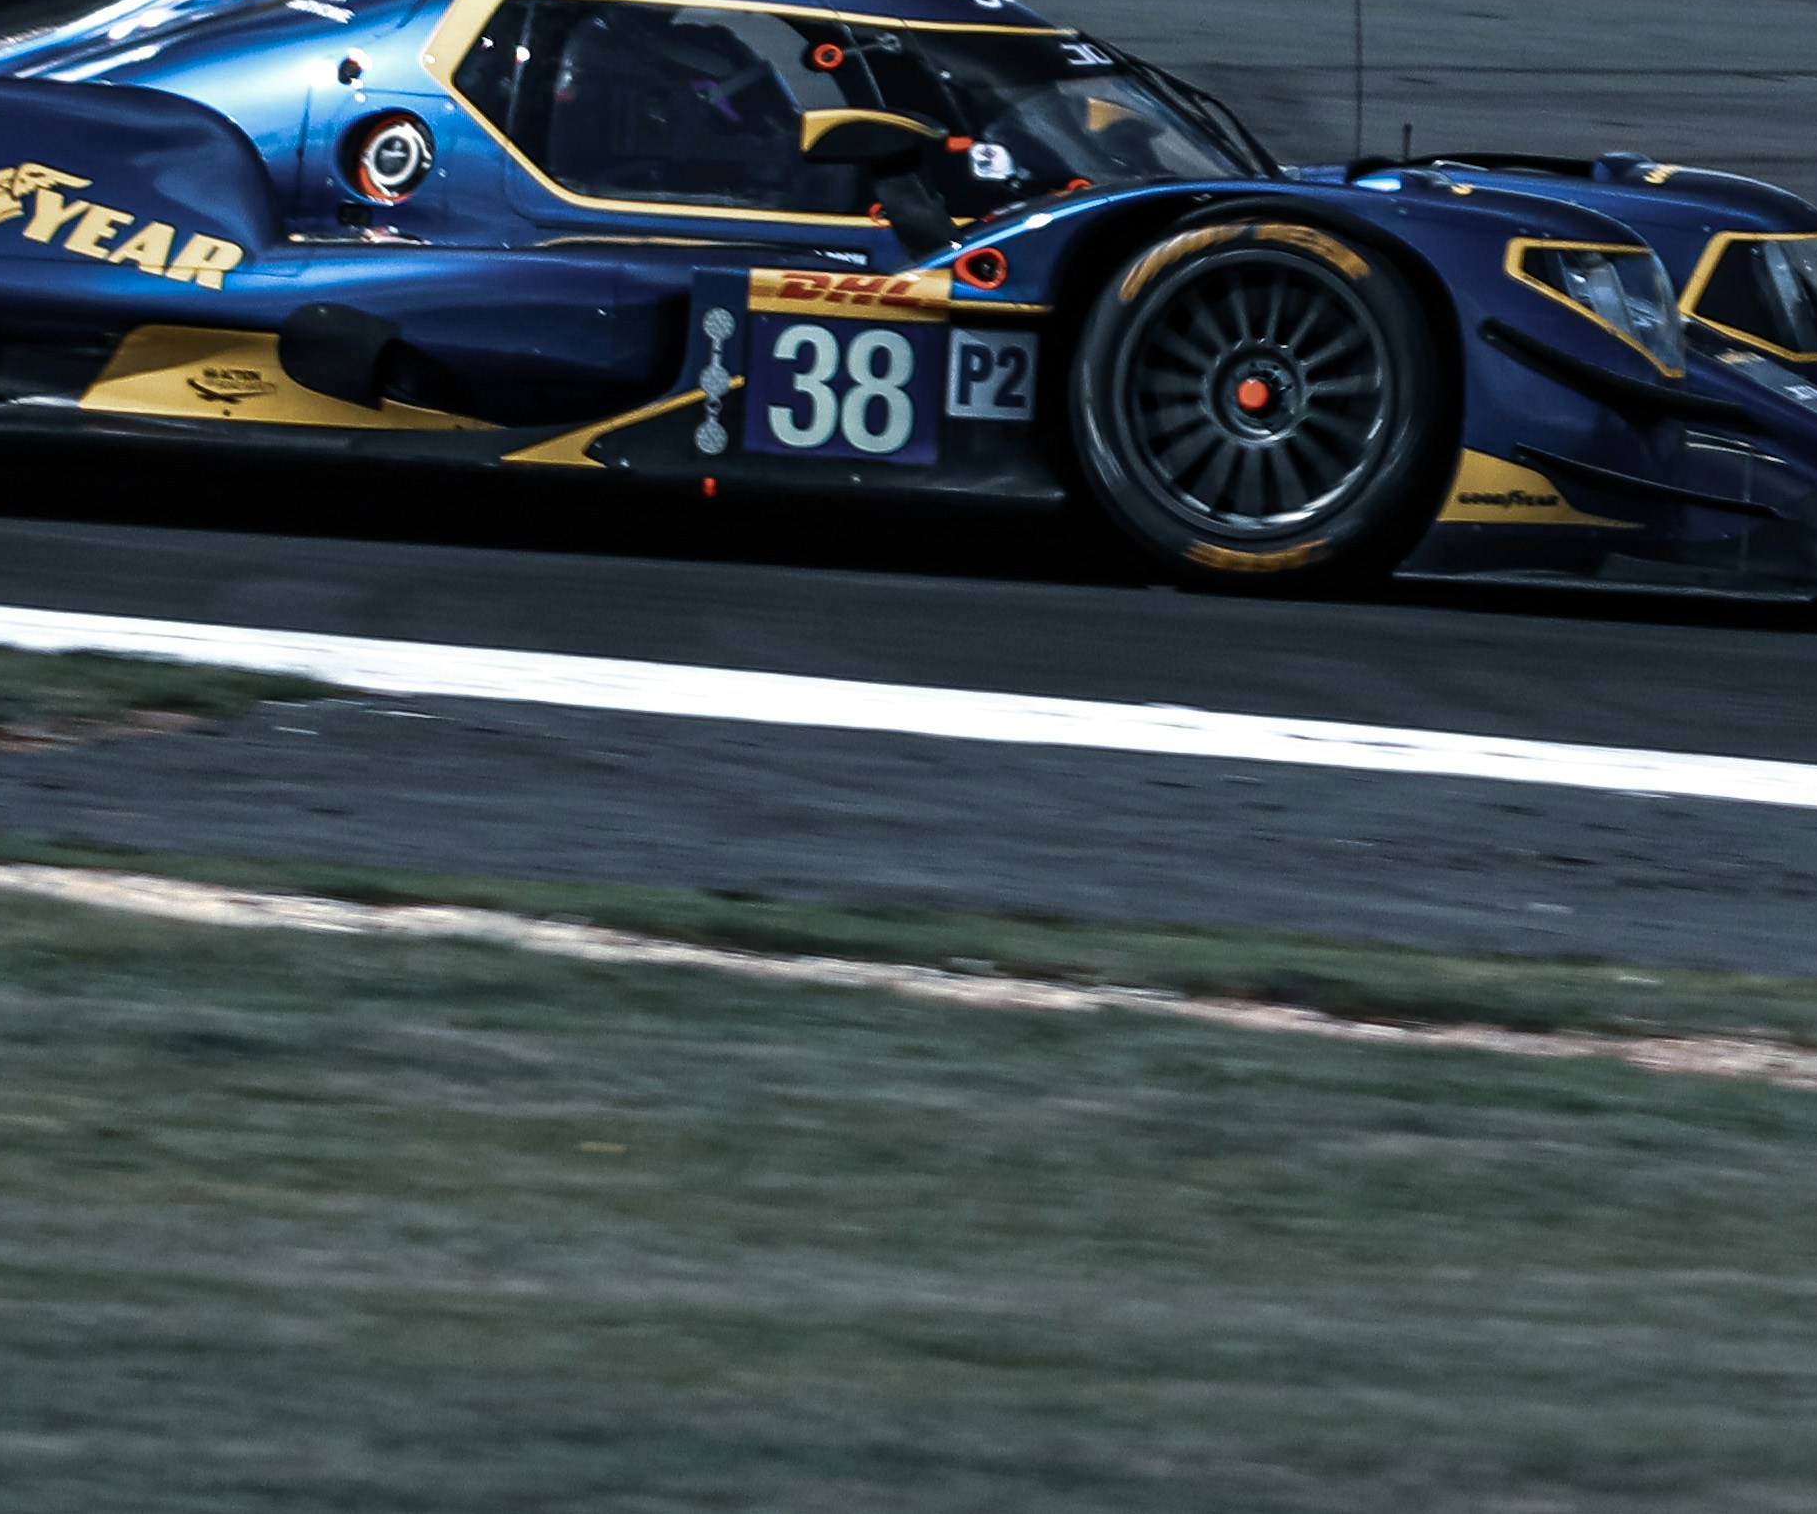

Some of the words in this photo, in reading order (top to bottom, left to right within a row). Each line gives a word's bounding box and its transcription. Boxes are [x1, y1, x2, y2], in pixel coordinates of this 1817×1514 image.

[779, 271, 923, 309] DHL
[767, 323, 916, 454] 38
[956, 342, 1033, 408] P2
